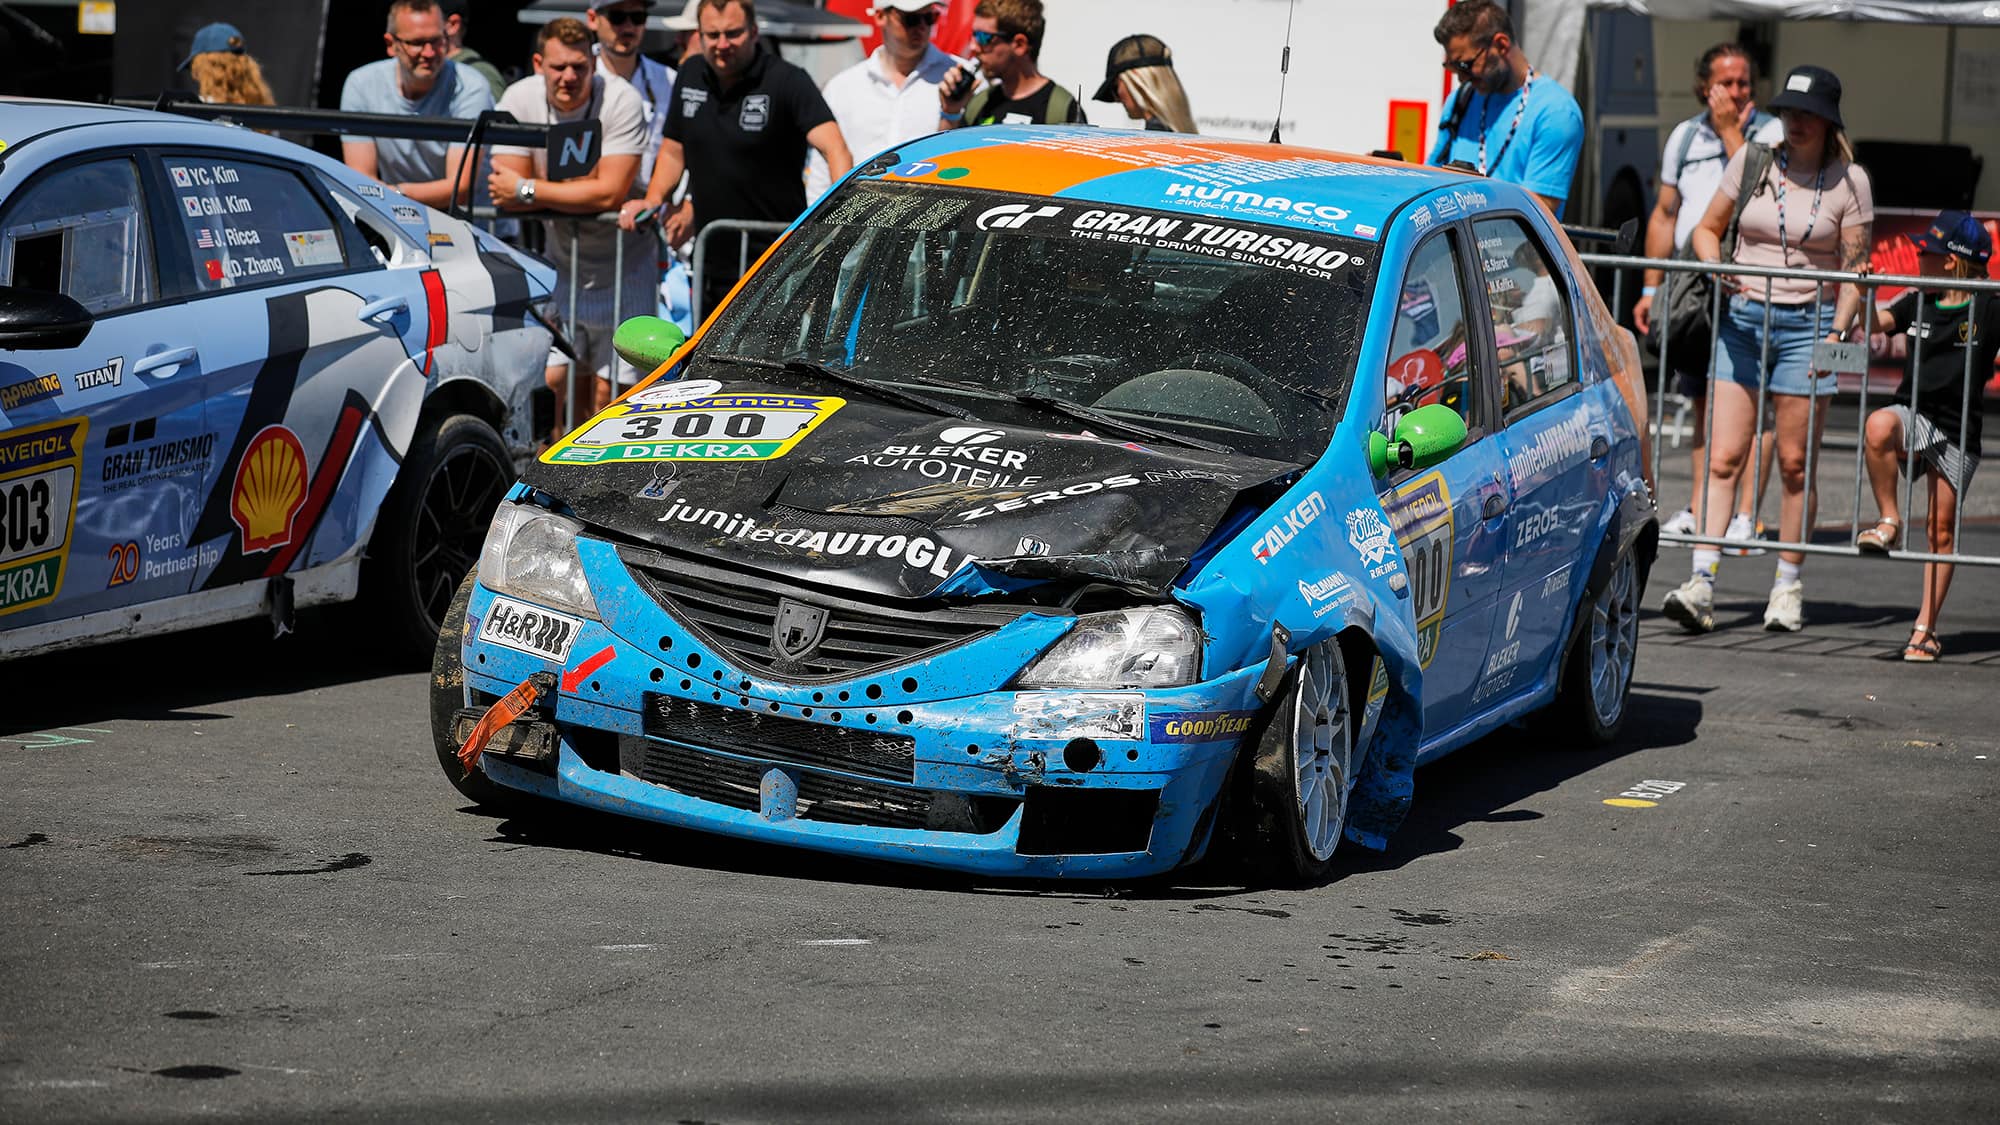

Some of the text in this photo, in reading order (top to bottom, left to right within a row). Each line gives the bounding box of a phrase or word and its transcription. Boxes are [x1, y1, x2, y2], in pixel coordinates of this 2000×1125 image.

[189, 165, 240, 184] YC. Kim
[201, 196, 252, 216] GM. Kim
[1165, 183, 1350, 221] KUMACO
[1232, 202, 1282, 218] besser
[1285, 213, 1340, 232] werben
[214, 227, 261, 247] J. Ricca
[1072, 210, 1183, 238] GRAN
[245, 256, 285, 276] Zhang
[1070, 229, 1333, 281] THE REAL DRIVING SIMULATOR
[20, 375, 61, 398] RACING
[75, 356, 124, 391] TITAN7
[621, 413, 766, 440] 300
[103, 449, 144, 482] GRAN
[622, 444, 760, 459] DEKRA
[883, 446, 1028, 471] BLEKER
[844, 454, 1042, 489] AUTOTEILE
[103, 484, 118, 494] THE
[119, 480, 137, 491] REAL
[957, 473, 1141, 522] ZEROS
[1251, 490, 1327, 566] FALKEN
[1354, 512, 1382, 541] Ollis
[1515, 504, 1560, 549] ZEROS
[108, 532, 181, 588] 20 Years
[145, 544, 219, 581] Partnership
[1369, 560, 1398, 579] RACING
[1404, 537, 1443, 620] 00
[485, 602, 539, 646] H&R
[1486, 640, 1521, 677] BLEKER
[1165, 713, 1252, 739] GOODYEAR
